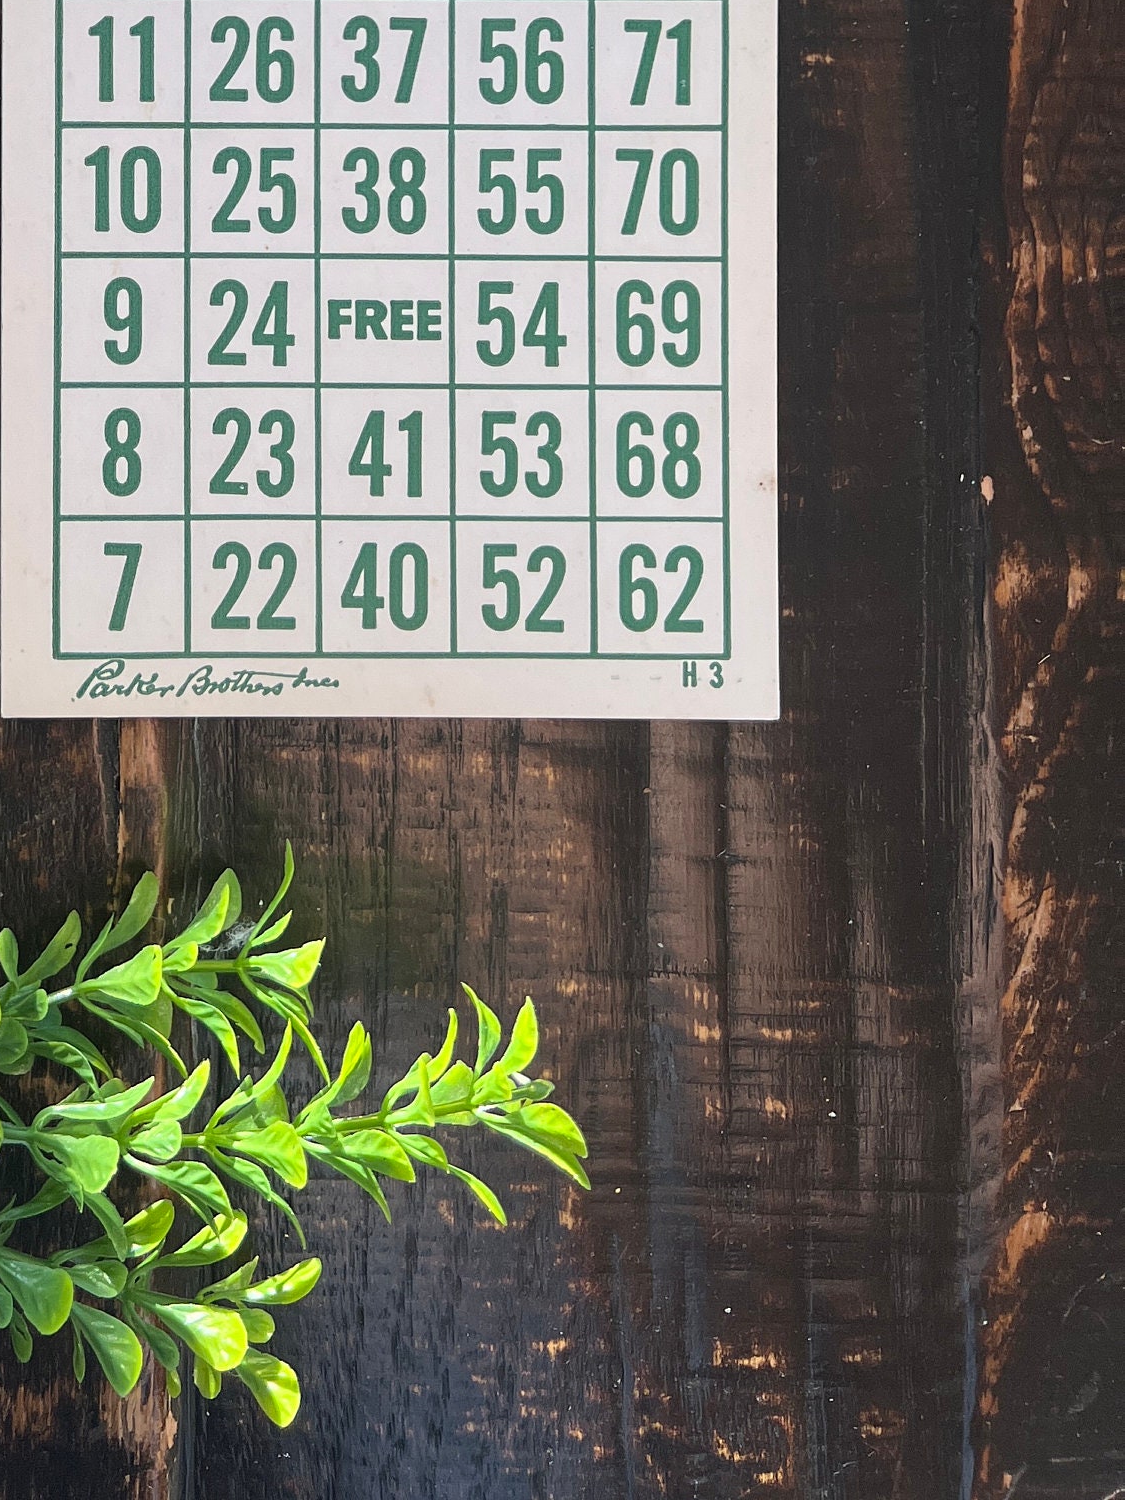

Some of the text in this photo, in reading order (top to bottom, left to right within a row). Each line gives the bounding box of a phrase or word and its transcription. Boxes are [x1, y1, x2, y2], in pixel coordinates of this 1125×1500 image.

[89, 15, 691, 106] 11 26 37 56 71
[86, 147, 699, 236] 10 25 38 55 70
[103, 277, 701, 368] 9 24 FREE 54 69
[102, 408, 700, 499] 8 23 41 53 68
[104, 542, 704, 633] 7 22 40 52 62
[75, 659, 176, 699] Parker
[175, 665, 284, 698] Brothers
